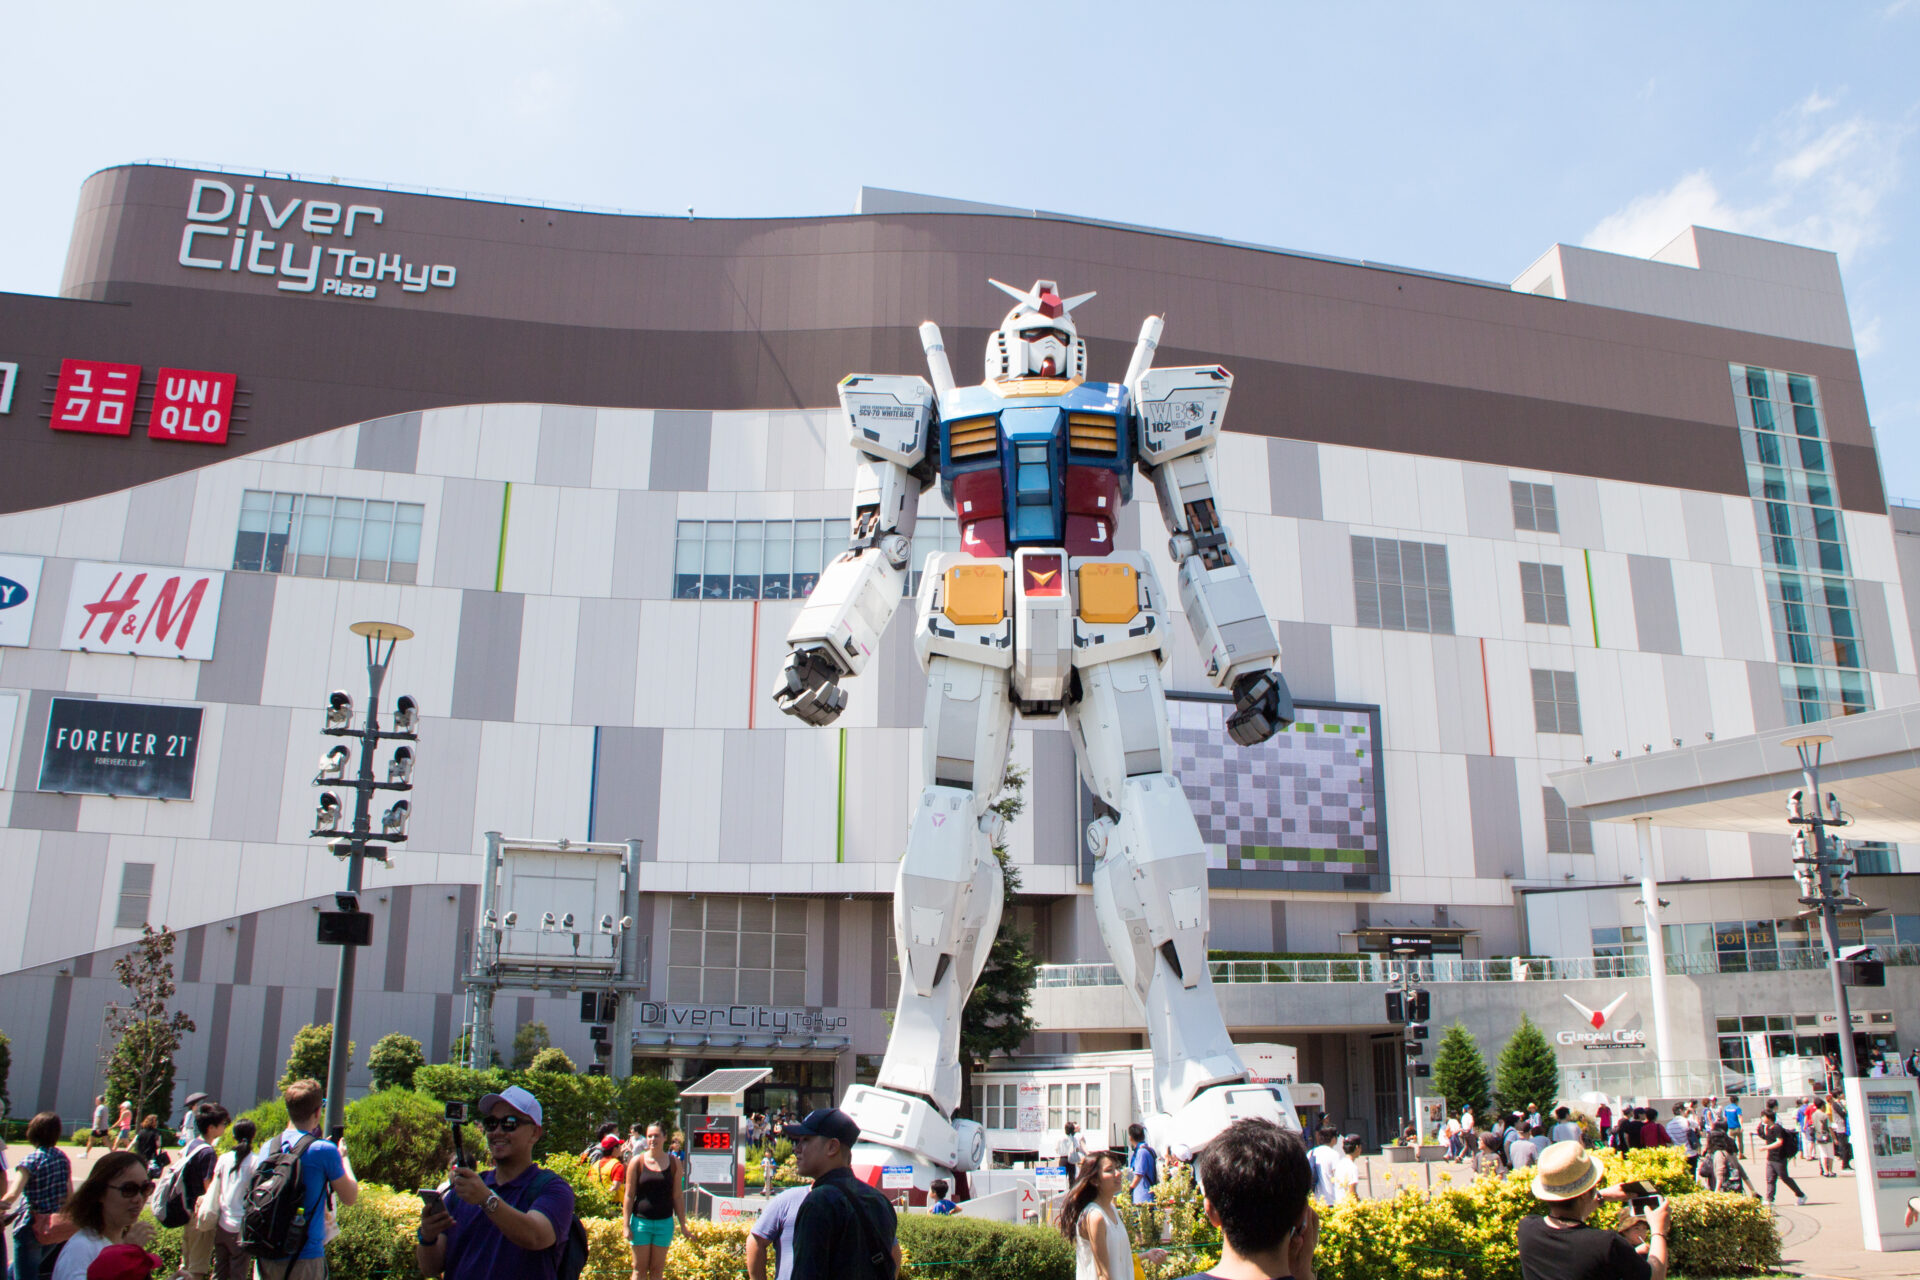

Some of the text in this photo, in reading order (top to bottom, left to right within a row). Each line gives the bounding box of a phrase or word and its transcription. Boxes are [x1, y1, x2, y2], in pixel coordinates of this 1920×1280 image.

[187, 178, 383, 236] Diver
[178, 223, 322, 292] City
[322, 278, 377, 299] Plaza
[68, 369, 127, 397] ユニ
[165, 377, 222, 404] UNI
[160, 405, 221, 435] QLO
[1152, 422, 1171, 432] 102
[79, 571, 209, 650] H&M
[56, 728, 188, 757] FOREVER 21
[1716, 933, 1772, 945] COFEE
[703, 1133, 730, 1149] 993
